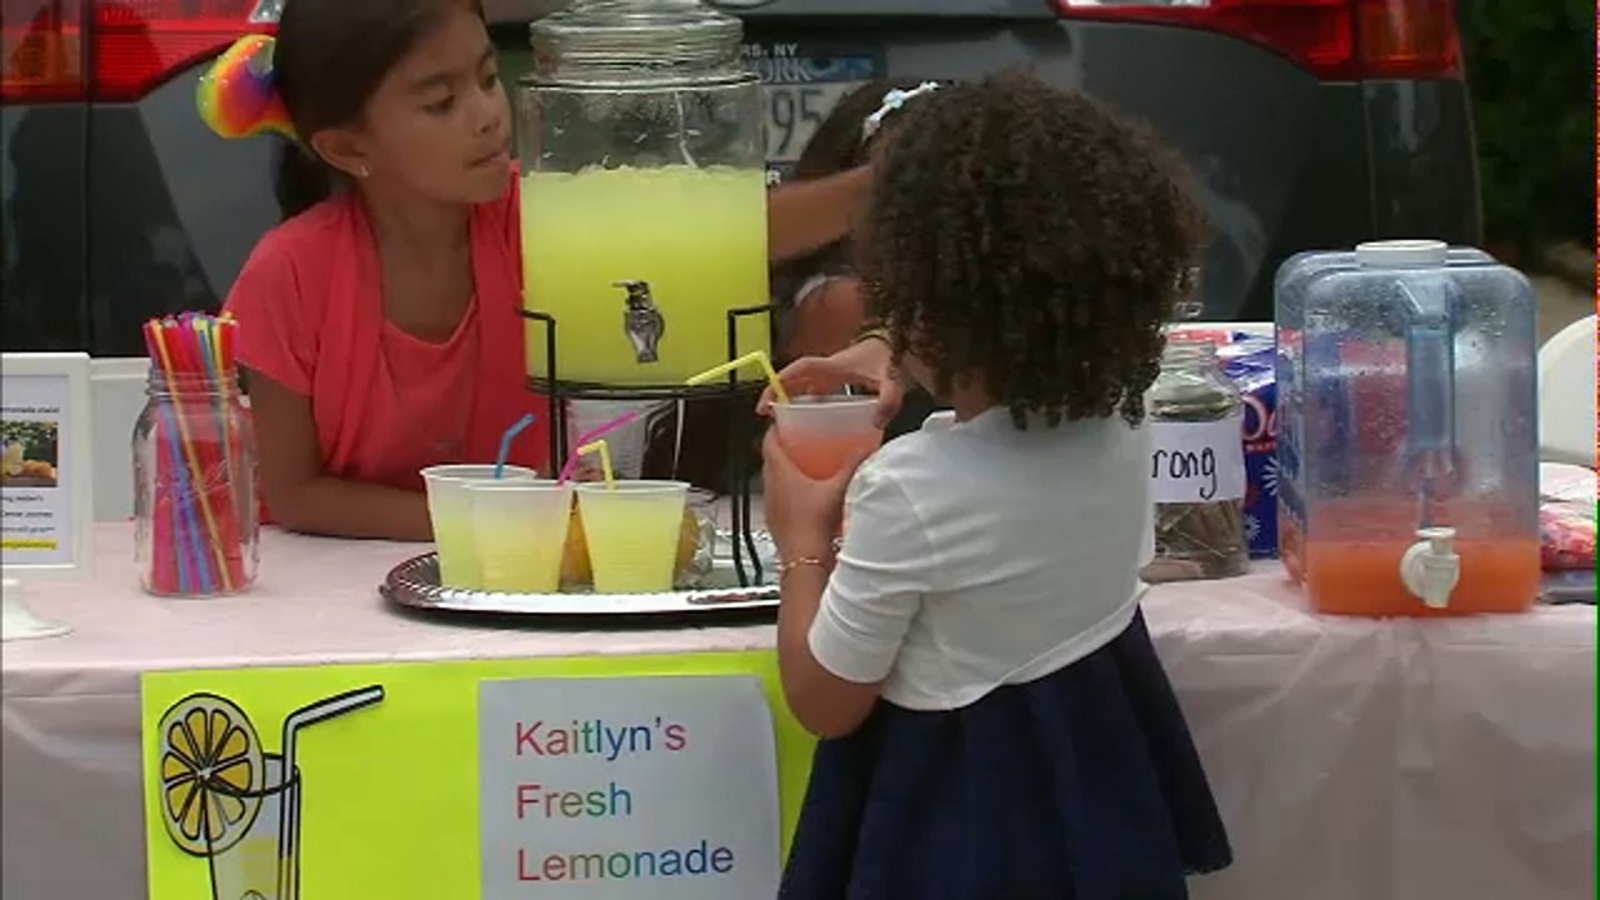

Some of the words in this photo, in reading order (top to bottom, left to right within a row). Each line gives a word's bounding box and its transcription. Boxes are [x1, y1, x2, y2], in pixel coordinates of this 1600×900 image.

[774, 43, 798, 56] NY
[1152, 447, 1217, 500] rong
[516, 716, 686, 762] Kaitlyn's
[516, 782, 631, 819] Fresh
[518, 839, 735, 881] Lemonade
